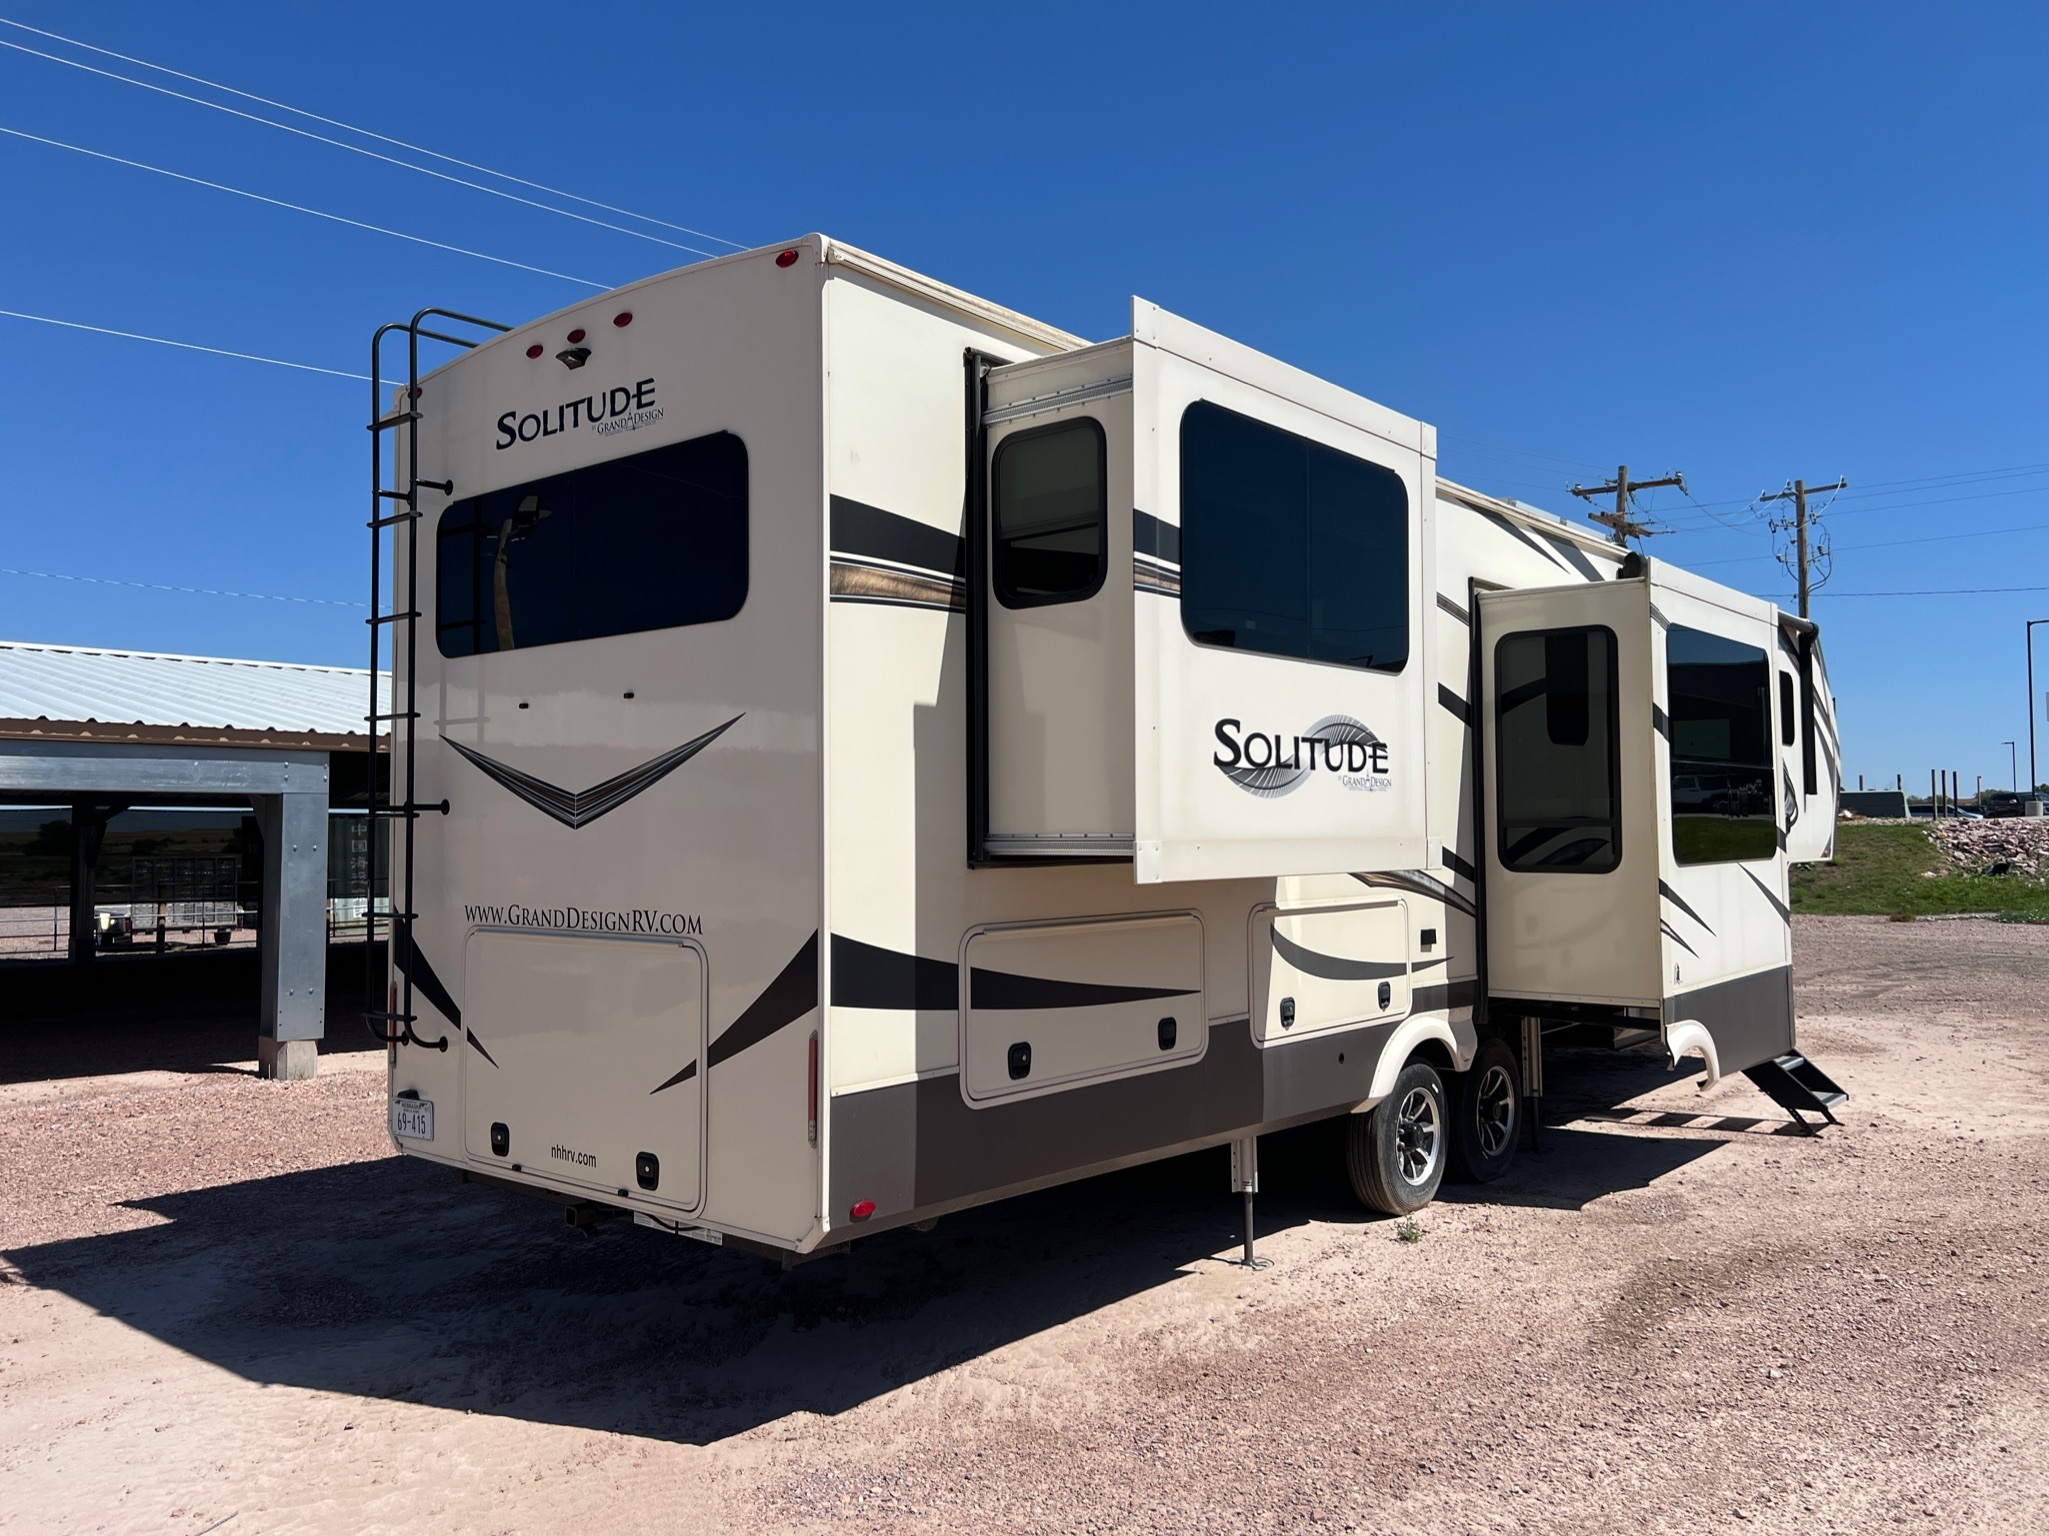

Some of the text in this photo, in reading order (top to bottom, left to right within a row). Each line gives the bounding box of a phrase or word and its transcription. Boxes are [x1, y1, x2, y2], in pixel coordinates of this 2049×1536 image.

[496, 377, 656, 450] SOLITUDE
[597, 417, 627, 434] GRAND
[634, 407, 664, 424] DESIGN
[1213, 718, 1389, 774] SOLITUDE
[1342, 775, 1366, 786] GRAND
[1370, 776, 1391, 787] DESIGN
[397, 1112, 426, 1134] 69-415
[551, 1144, 597, 1168] nhhrv.com
